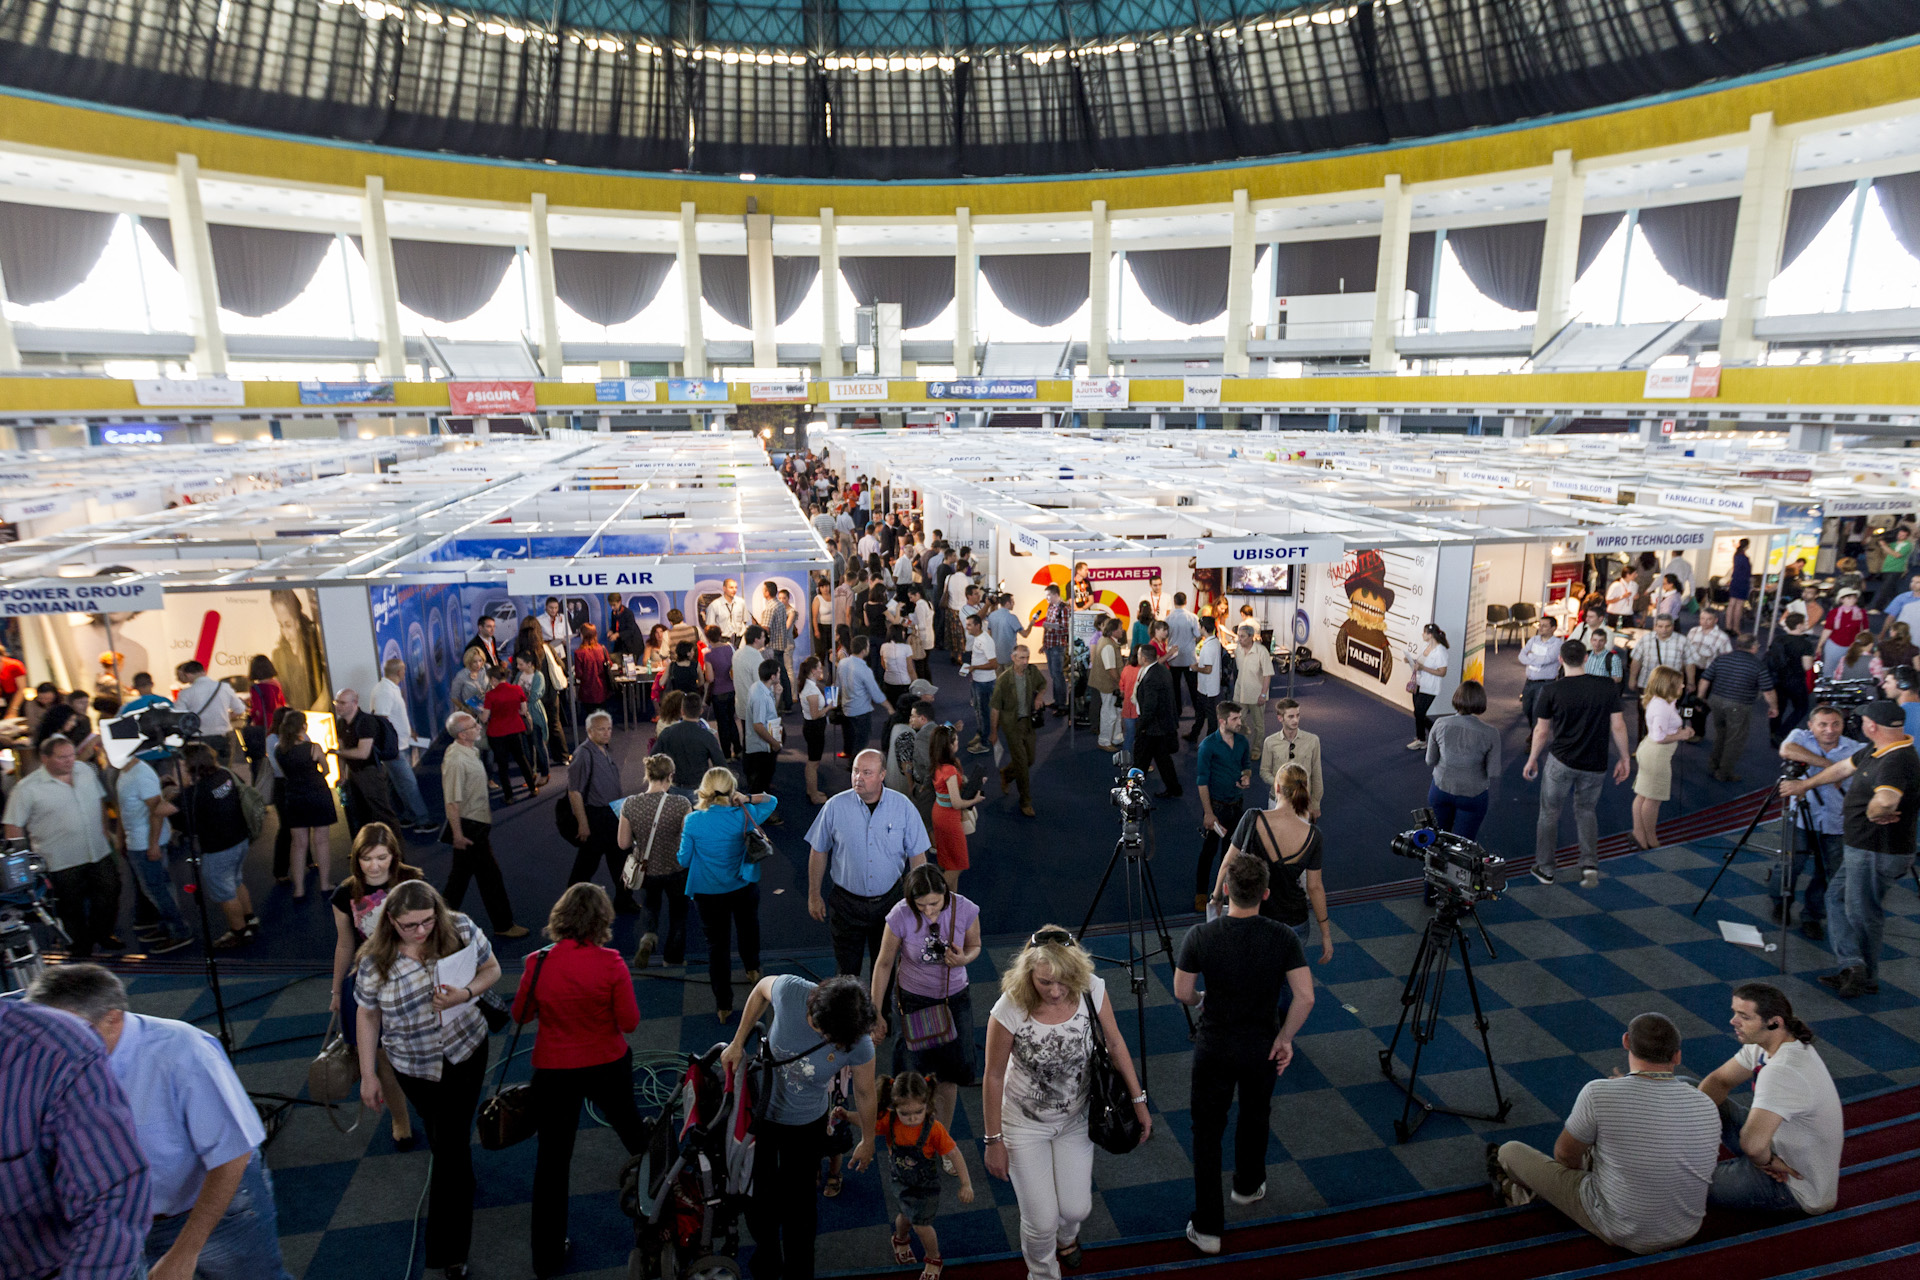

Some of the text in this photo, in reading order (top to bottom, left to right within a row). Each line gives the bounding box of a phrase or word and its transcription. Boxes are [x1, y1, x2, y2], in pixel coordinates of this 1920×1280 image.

[465, 389, 520, 403] ASIGURA
[835, 383, 883, 395] TIMKEN
[930, 382, 944, 398] hp
[950, 384, 1034, 394] LET'S DO AMAZING
[1194, 387, 1218, 396] cegeka
[1665, 493, 1745, 509] FARMACIILE DONA
[1833, 500, 1913, 512] FARMACIILE DONA
[1018, 532, 1039, 550] UBISOFT
[1596, 533, 1705, 547] WIPRO TECHNOLOGIES
[1233, 546, 1309, 560] UBISOFT
[1332, 549, 1384, 581] WANTED
[549, 571, 653, 587] BLUE AIR
[1088, 569, 1159, 580] UCHAREST
[76, 585, 145, 599] GROUP
[1412, 584, 1423, 596] 60
[4, 601, 99, 615] ROMANIA
[1411, 614, 1420, 626] 57
[170, 639, 194, 650] Job
[1408, 641, 1418, 655] 52
[1349, 645, 1380, 669] TALENT
